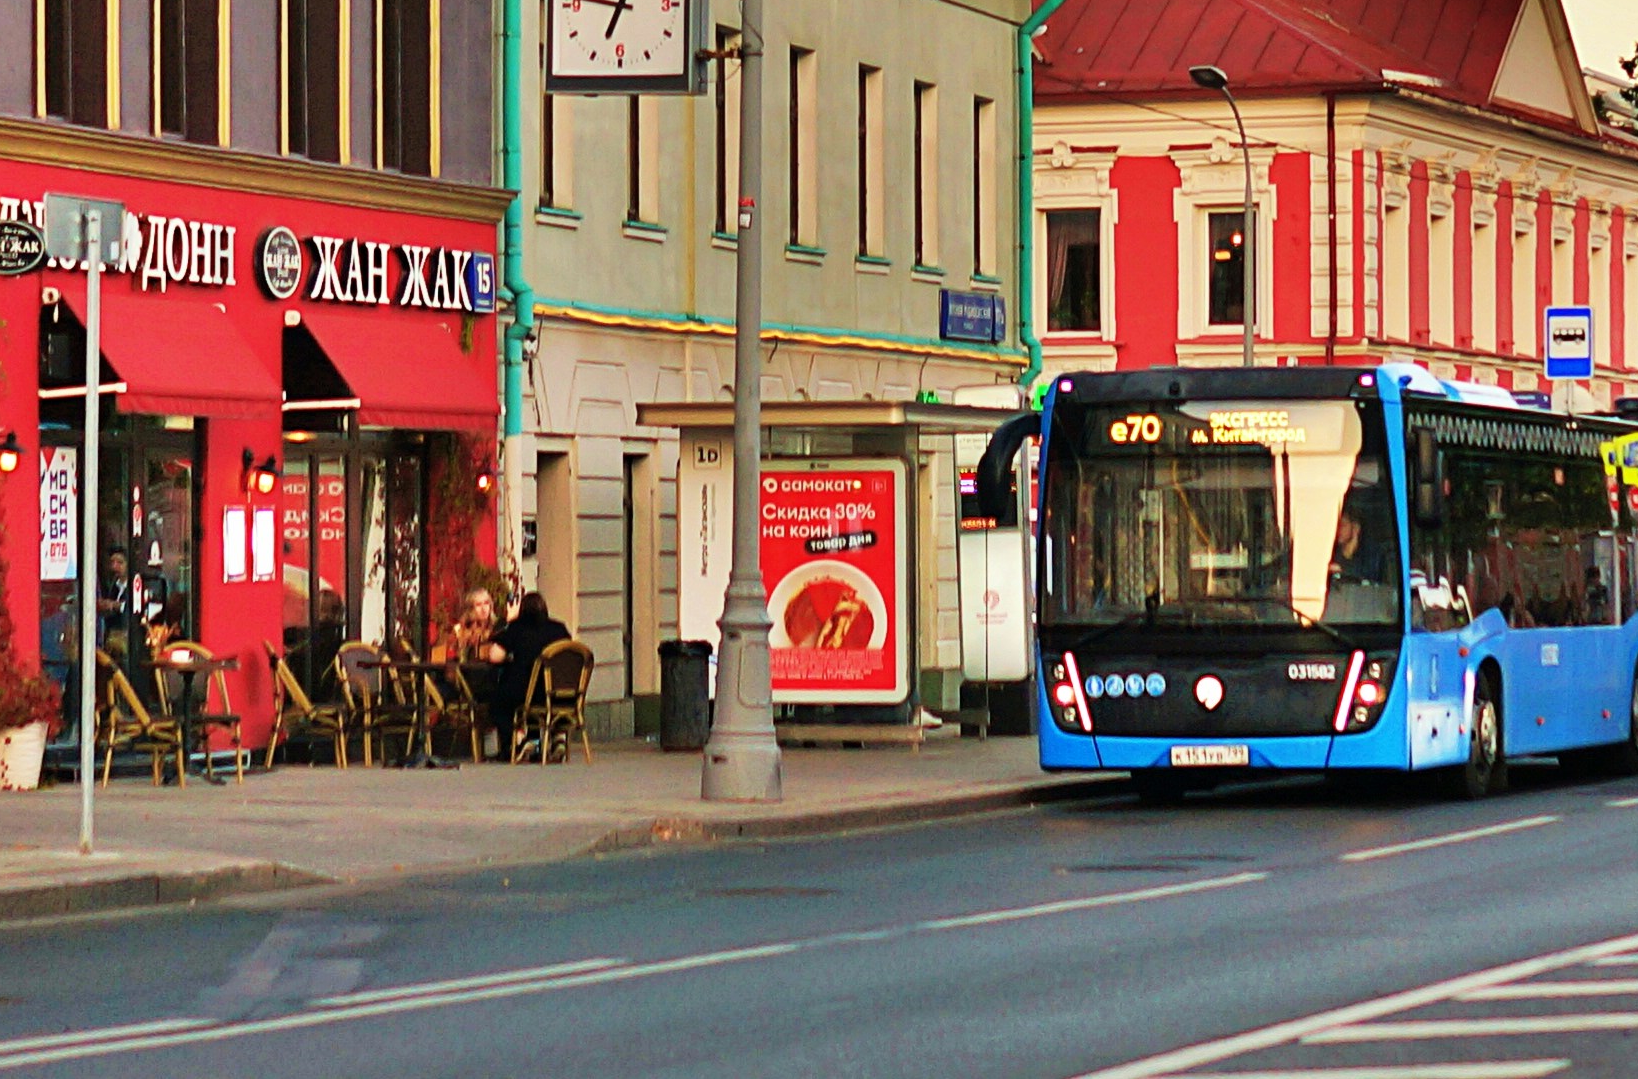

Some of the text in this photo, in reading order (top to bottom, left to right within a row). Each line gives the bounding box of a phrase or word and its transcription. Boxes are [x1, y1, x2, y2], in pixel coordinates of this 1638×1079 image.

[615, 44, 625, 58] 6
[142, 215, 236, 293] ДОНН
[311, 236, 473, 311] ЖАН ЖАК
[477, 262, 490, 294] 15
[1209, 411, 1289, 428] ЭКСПРЕСС
[49, 470, 67, 491] МО
[781, 479, 853, 492] самокат
[49, 494, 67, 515] СК
[762, 502, 876, 521] Скидка 30%
[49, 519, 67, 540] ВА
[763, 525, 832, 538] на коин
[810, 532, 872, 551] товар дня
